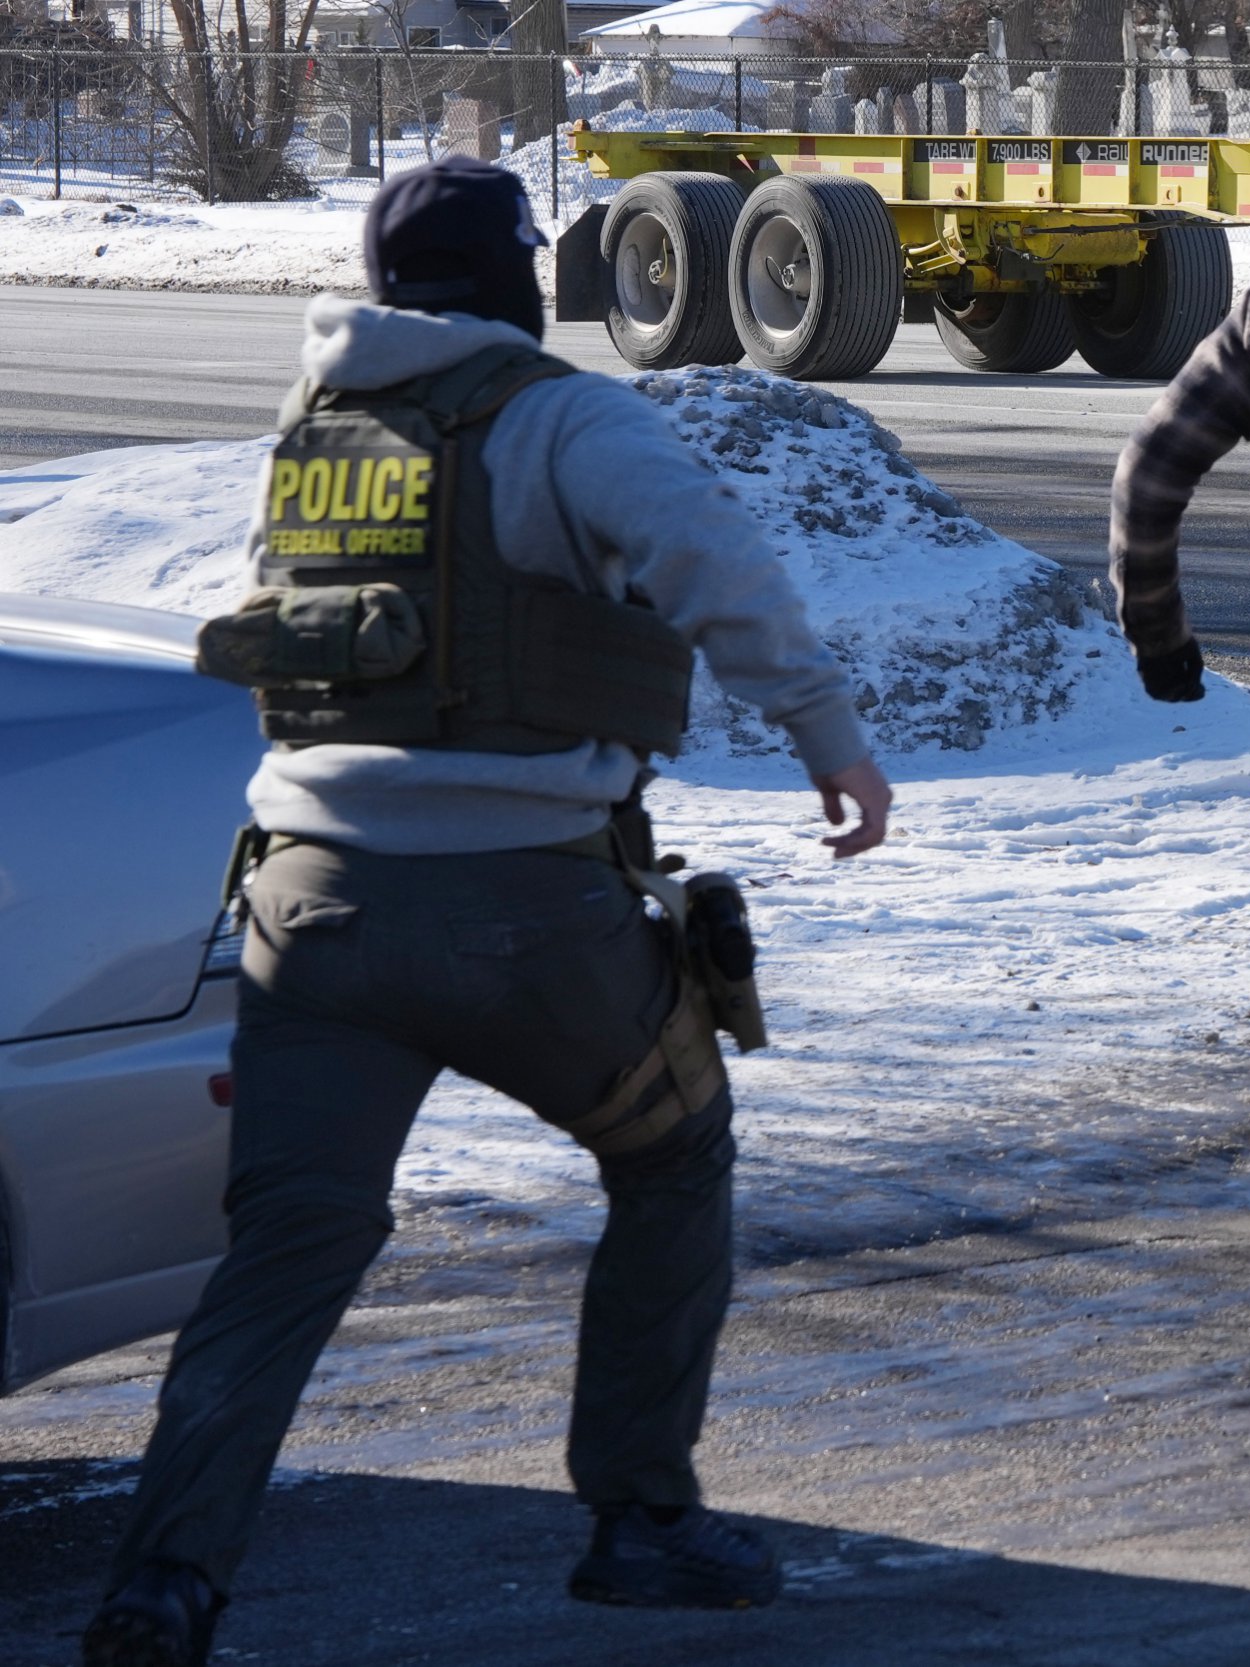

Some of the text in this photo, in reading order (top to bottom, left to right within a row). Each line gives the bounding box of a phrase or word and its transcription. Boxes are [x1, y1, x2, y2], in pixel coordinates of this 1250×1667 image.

[926, 143, 1049, 162] TARE WT 7,900 LBS
[271, 456, 433, 523] POLICE
[269, 527, 426, 555] FEDERAL OFFICER
